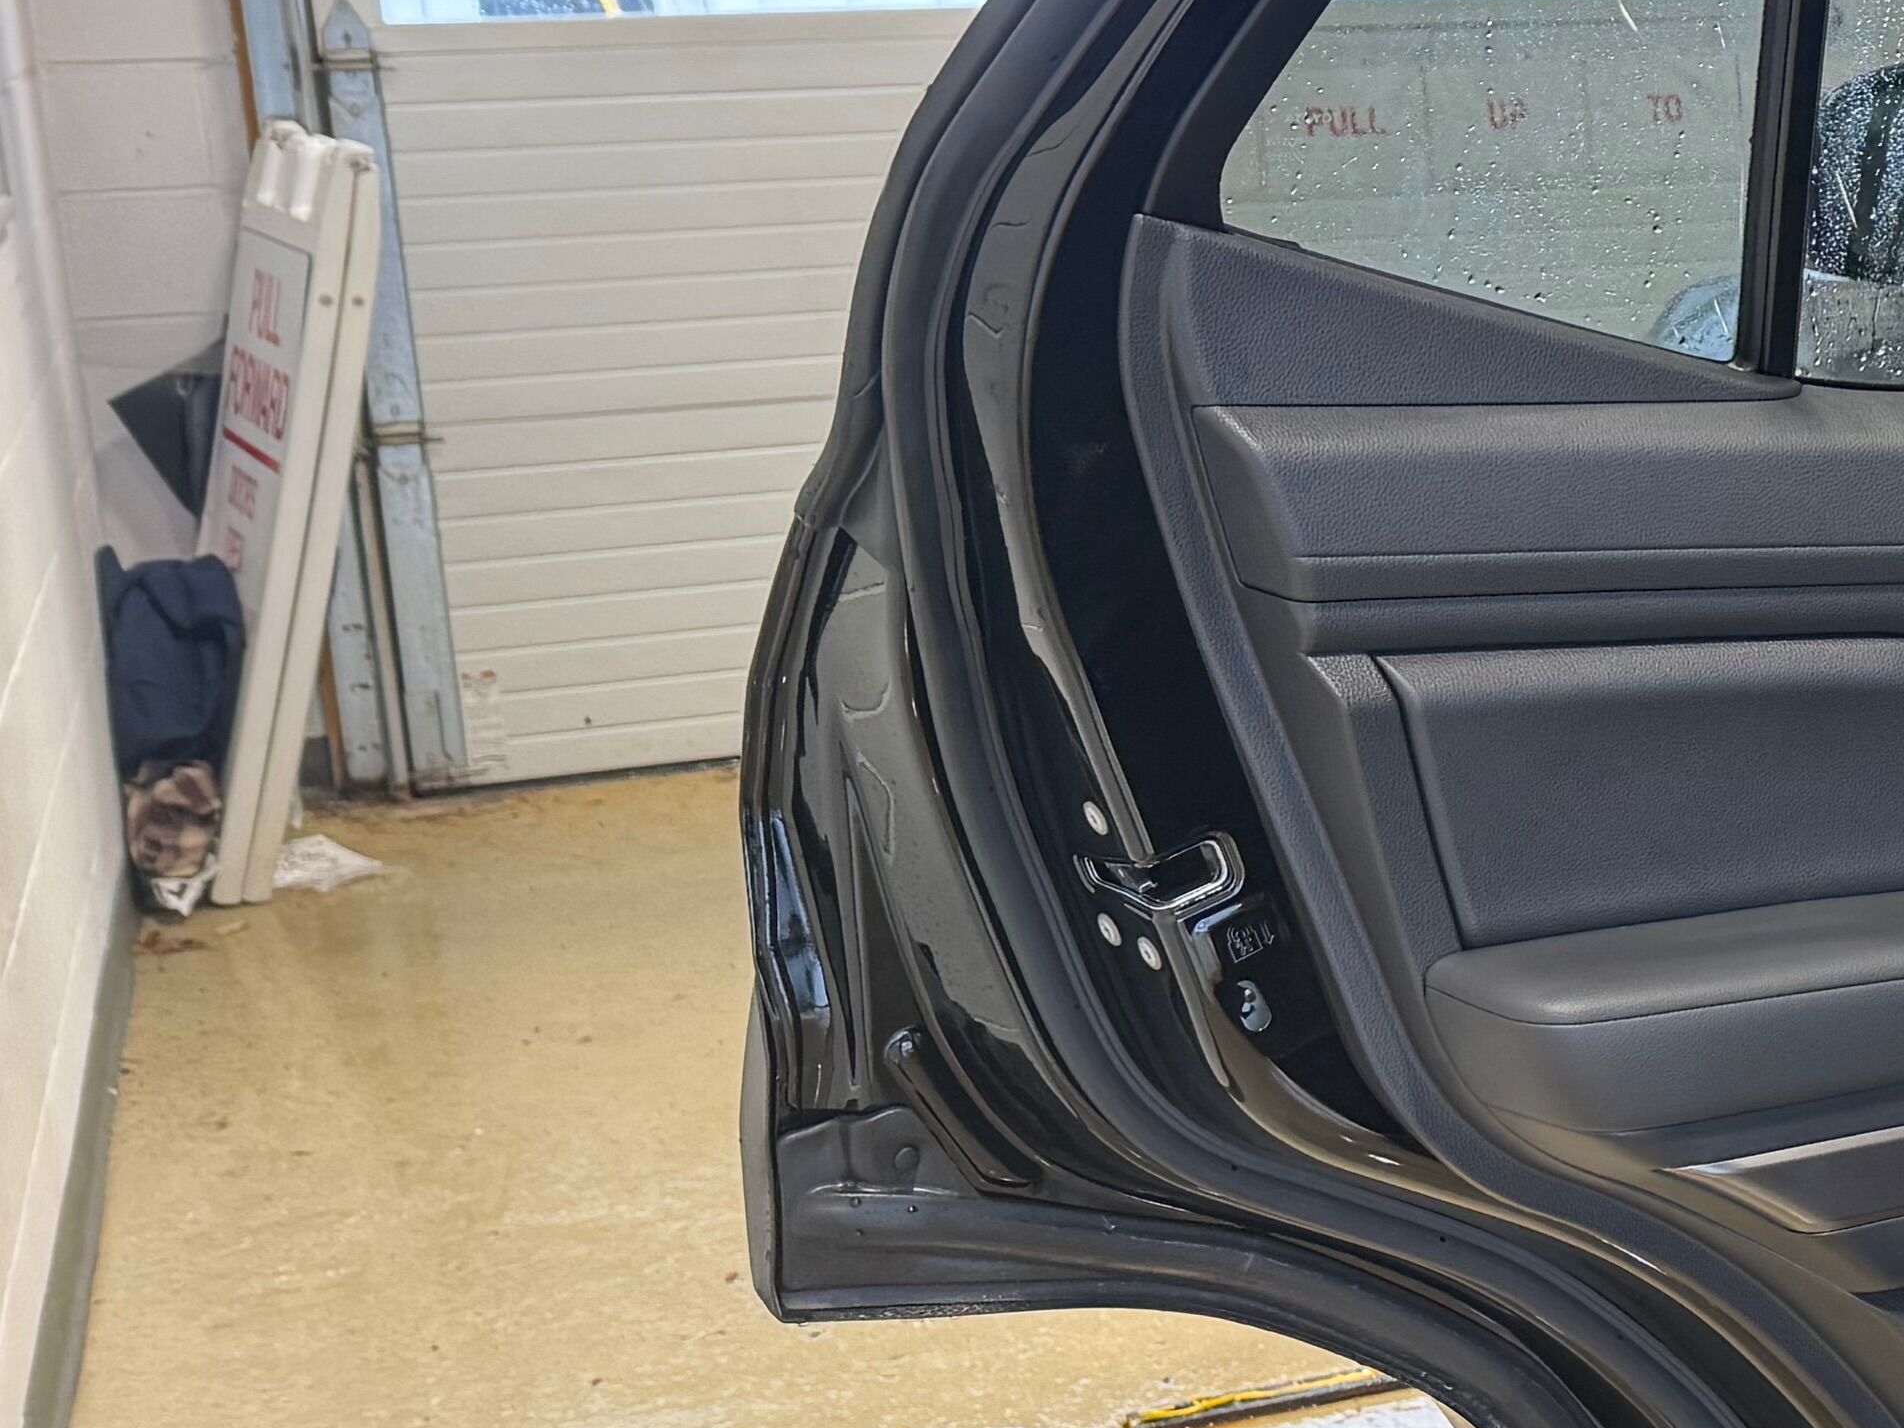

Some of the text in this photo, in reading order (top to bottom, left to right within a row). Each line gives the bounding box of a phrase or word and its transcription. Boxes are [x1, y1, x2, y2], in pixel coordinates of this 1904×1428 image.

[1305, 104, 1388, 138] PULL
[1484, 94, 1530, 132] UP
[1646, 91, 1685, 125] TO
[249, 269, 282, 347] PULL
[227, 346, 289, 440] FORWARD
